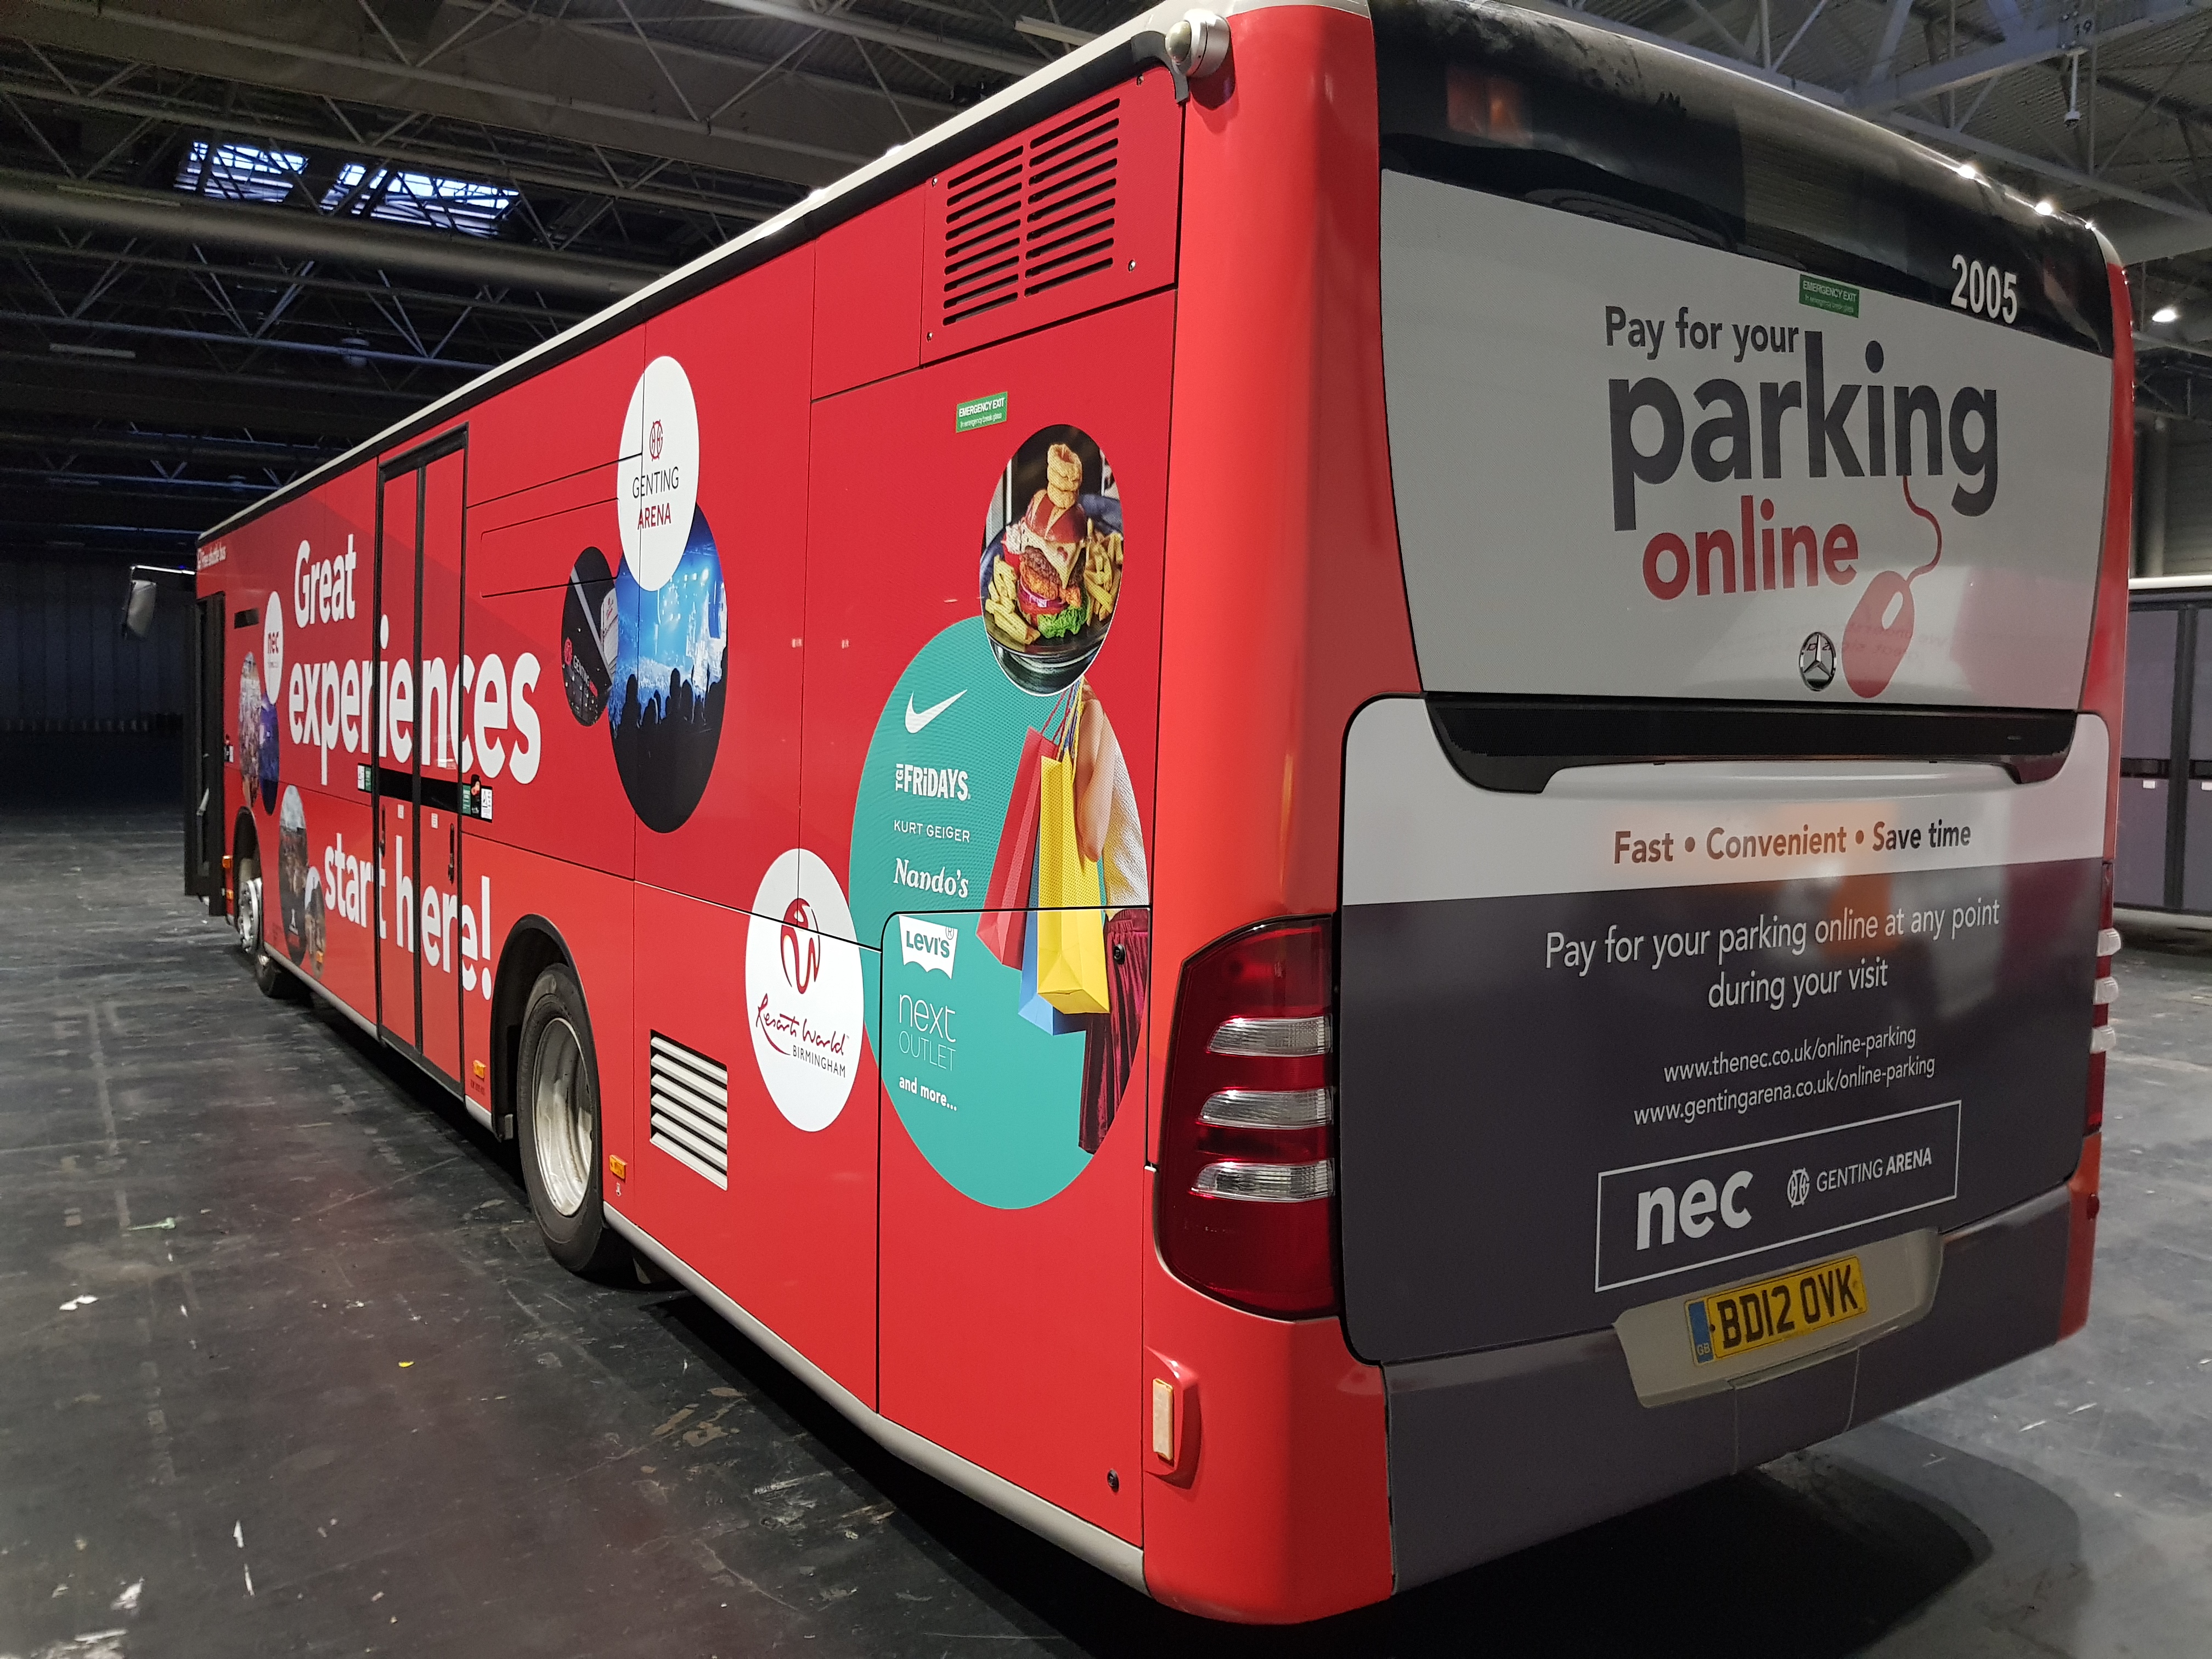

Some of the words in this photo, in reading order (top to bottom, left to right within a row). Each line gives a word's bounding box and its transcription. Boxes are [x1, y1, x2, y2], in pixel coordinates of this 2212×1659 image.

[1803, 280, 1842, 298] EMERGENCY
[1843, 291, 1857, 303] EXIT
[1950, 254, 2018, 324] 2005
[1605, 306, 1664, 360] Pay
[1675, 307, 1723, 350] for
[1731, 324, 1799, 363] your
[959, 400, 992, 417] EMERGENCY
[992, 398, 1005, 409] EXIT
[1608, 331, 1999, 532] parking
[633, 466, 679, 499] GENTING
[637, 503, 672, 530] ARENA
[1643, 494, 1859, 601] online
[294, 534, 357, 628] Great
[268, 631, 279, 654] nec
[289, 614, 541, 785] experiences
[895, 763, 904, 791] TGI
[894, 820, 923, 836] KURT
[926, 825, 970, 843] GEIGER
[1613, 831, 1674, 864] Fast
[1706, 825, 1848, 860] Convenient
[1872, 821, 1921, 851] Save
[1928, 819, 1971, 848] time
[893, 857, 969, 898] Nando's
[324, 832, 386, 940] start
[395, 836, 491, 1001] here!
[1545, 931, 1596, 977] Pay
[1605, 924, 1644, 964] for
[1651, 928, 1711, 970] your
[1718, 915, 1808, 965] parking
[1815, 907, 1879, 945] online
[1884, 907, 1905, 937] at
[1910, 908, 1945, 941] any
[1951, 898, 2000, 942] point
[1708, 972, 1786, 1011] during
[1792, 968, 1842, 1008] your
[1847, 958, 1888, 991] visit
[756, 993, 800, 1048] Resort
[803, 1018, 845, 1056] World
[899, 994, 956, 1042] next
[793, 1045, 845, 1078] BIRMINGHAM
[899, 1030, 956, 1071] OUTLET
[1663, 1025, 1916, 1084] www.thenec.co.uk/online-parking
[899, 1076, 917, 1094] and
[920, 1085, 957, 1111] more...
[1634, 1055, 1936, 1126] www.gentingarena.co.uk/online-parking
[1816, 1158, 1883, 1192] GENTING
[1886, 1147, 1932, 1176] ARENA
[1636, 1170, 1754, 1251] nec
[1716, 1284, 1796, 1350] BD12
[1799, 1264, 1858, 1324] OVK
[1697, 1342, 1711, 1356] GB
